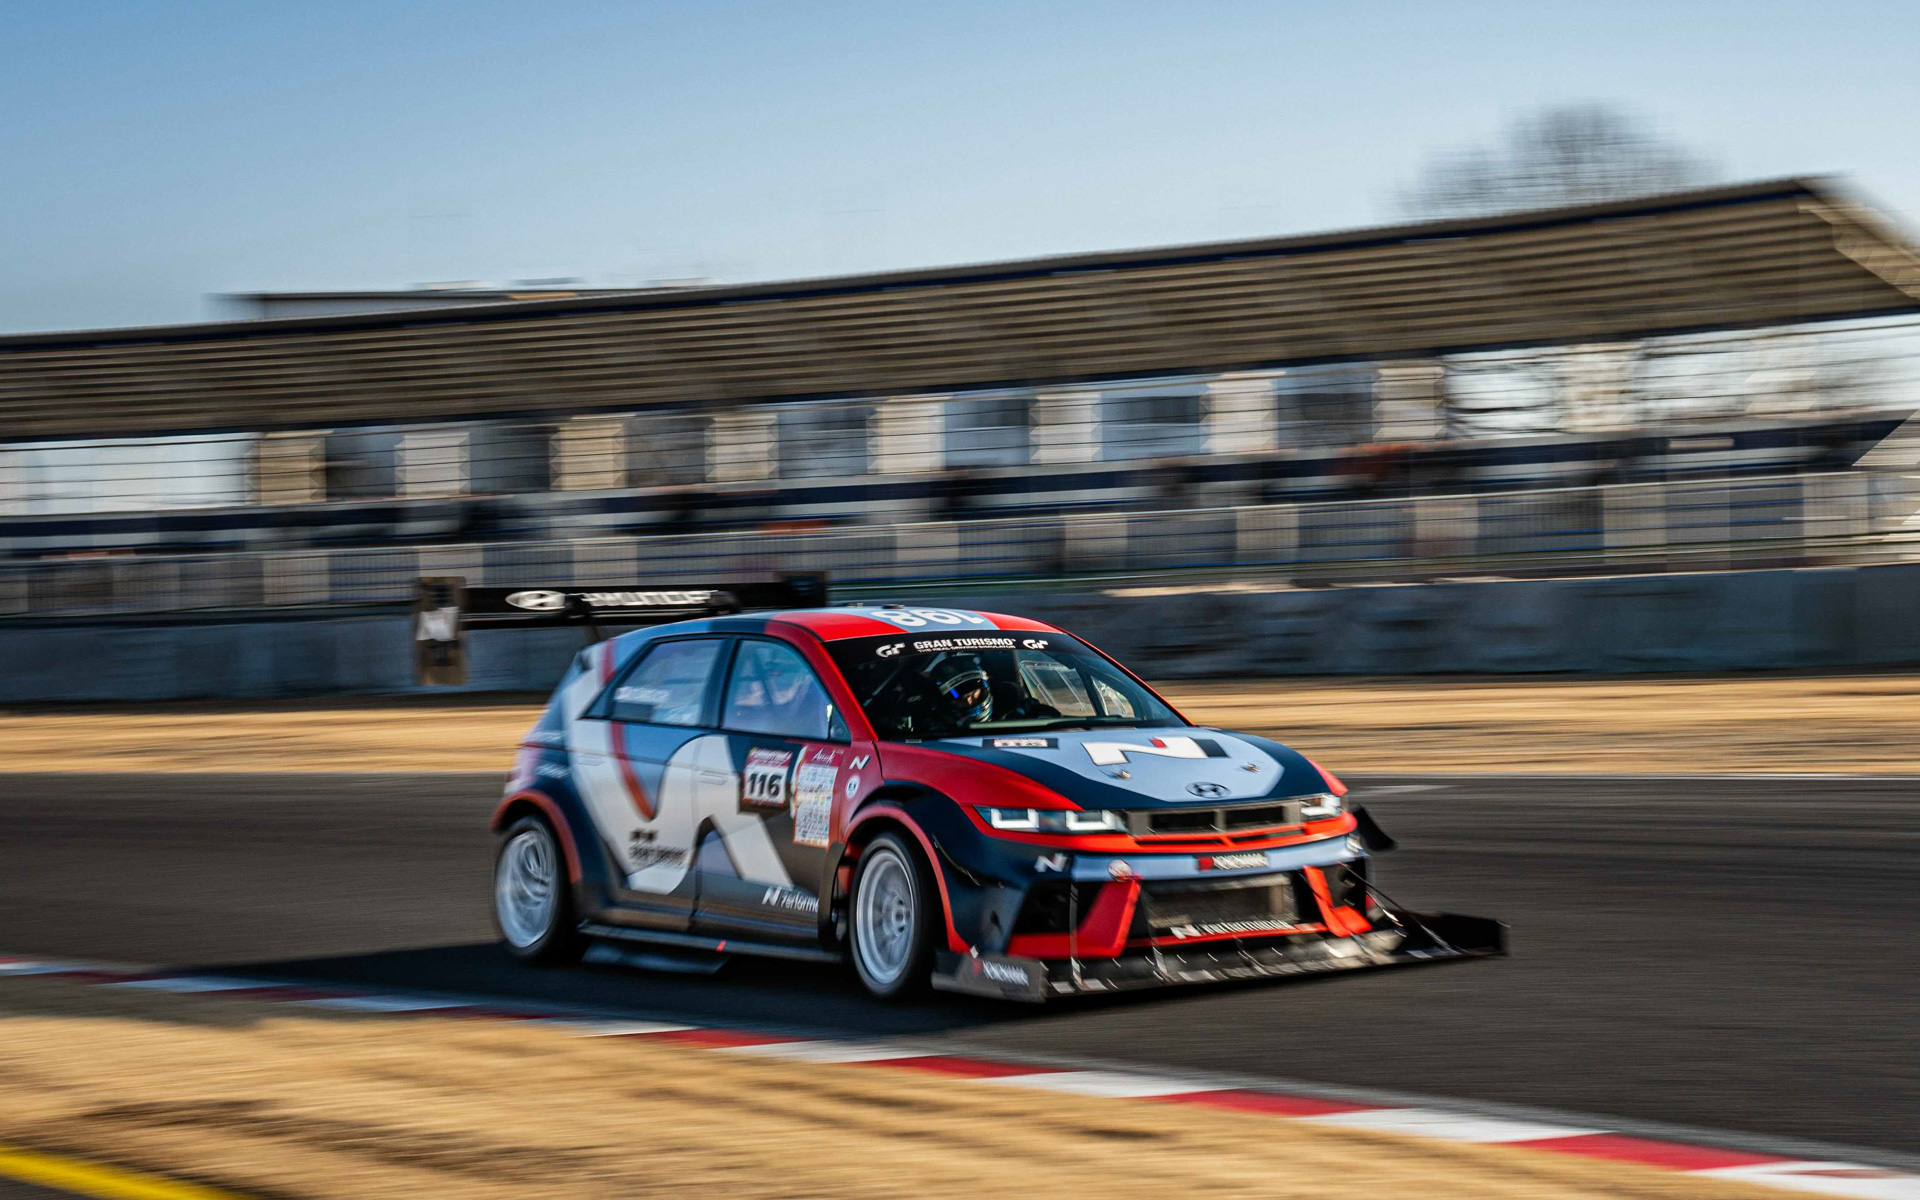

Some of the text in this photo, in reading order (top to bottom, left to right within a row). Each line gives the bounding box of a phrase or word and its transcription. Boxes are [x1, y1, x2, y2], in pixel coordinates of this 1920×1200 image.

[912, 639, 953, 650] GRAN
[848, 754, 870, 770] N
[748, 773, 782, 798] 116
[1034, 853, 1067, 872] N
